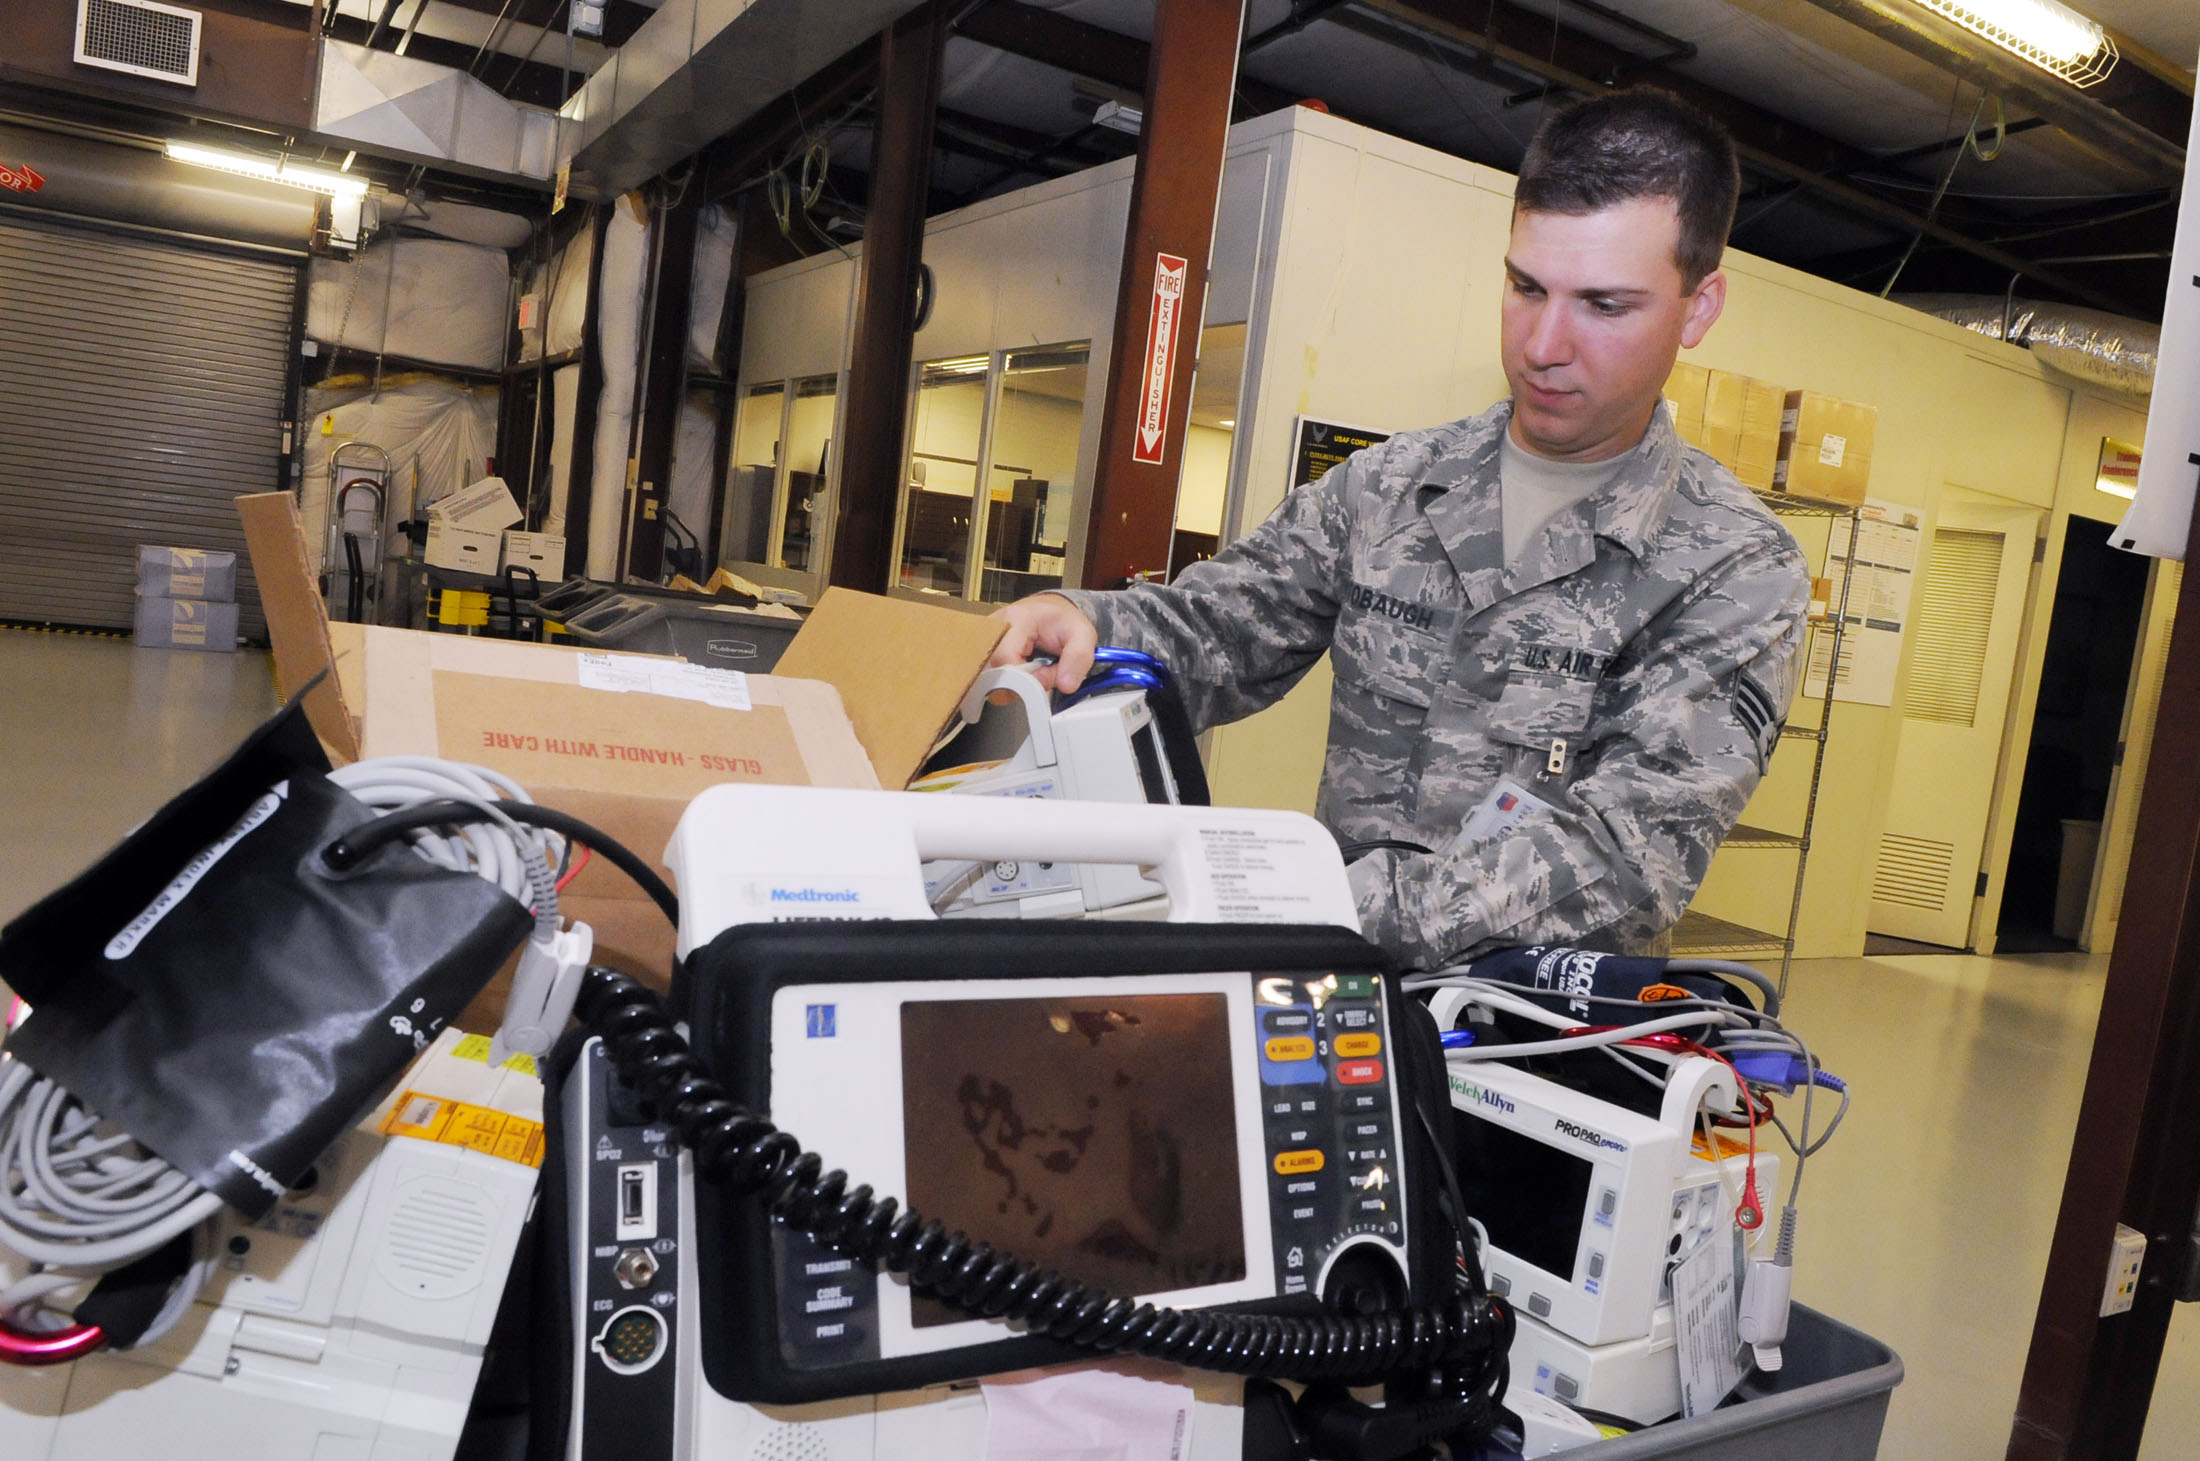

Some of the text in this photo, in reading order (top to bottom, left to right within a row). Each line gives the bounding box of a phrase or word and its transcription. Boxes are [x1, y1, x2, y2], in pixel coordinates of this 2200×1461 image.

[1158, 274, 1180, 294] FIRE
[1148, 299, 1171, 433] EXTINGUISHER
[1333, 435, 1350, 444] USAF
[1351, 438, 1367, 447] CORE
[1524, 647, 1551, 669] U.S.
[1558, 650, 1594, 677] AIR
[482, 731, 539, 751] CARE
[545, 738, 599, 759] WITH
[604, 744, 684, 767] HANDLE
[700, 754, 762, 775] GLASS
[771, 888, 860, 903] Medtronic
[1316, 1012, 1326, 1027] 2
[1319, 1040, 1328, 1056] 3
[1346, 1041, 1369, 1050] CHARGE
[1352, 1067, 1373, 1077] SHOCK
[1274, 1103, 1291, 1113] LEAD
[1555, 1119, 1601, 1144] PROPAQ
[1290, 1157, 1316, 1167] ALARMS
[1287, 1182, 1316, 1193] OPTIONS
[1293, 1208, 1314, 1219] EVENT
[593, 1299, 613, 1311] ECG
[806, 1296, 854, 1313] SUMMARY
[816, 1323, 844, 1338] PRINT
